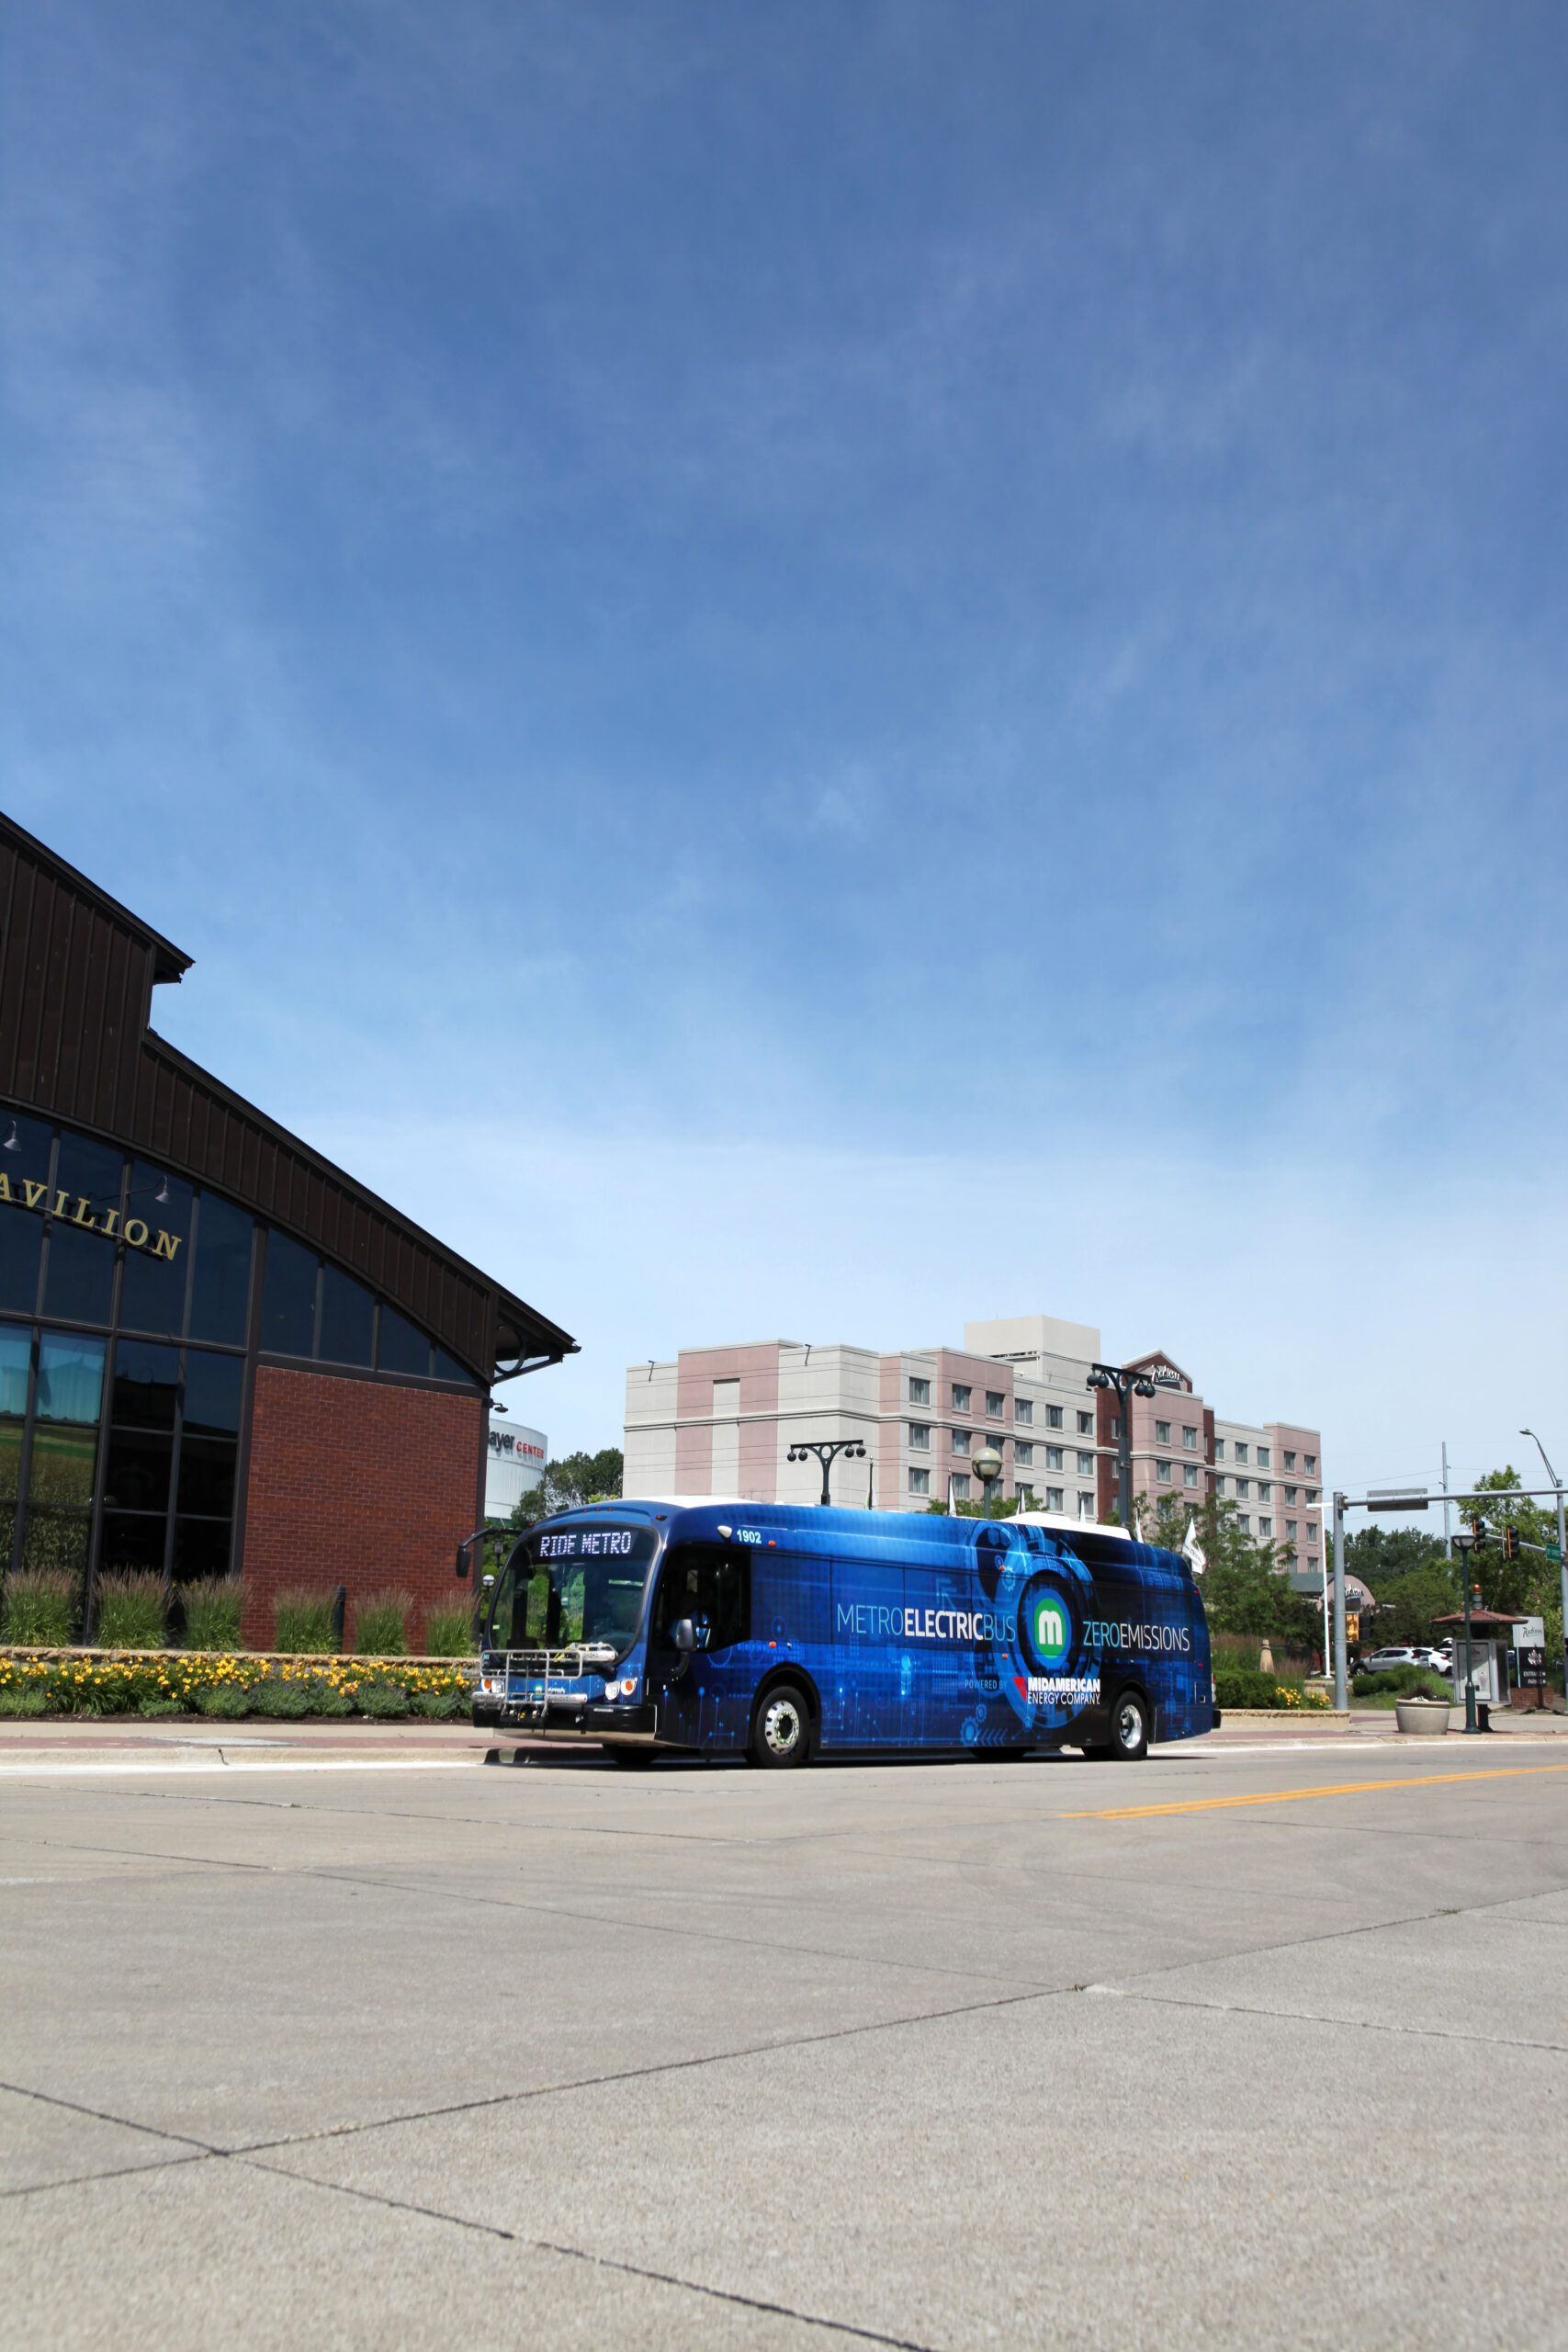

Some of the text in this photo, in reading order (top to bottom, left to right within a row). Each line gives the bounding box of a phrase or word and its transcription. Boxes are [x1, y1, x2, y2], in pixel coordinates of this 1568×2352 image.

[0, 1172, 182, 1261] AVILION
[488, 1430, 545, 1460] ayer CENTER
[540, 1532, 631, 1556] RIDE METRO
[737, 1529, 762, 1544] 1902
[964, 1679, 1008, 1690] POWERED BY
[1027, 1677, 1100, 1692] MIDAMERICAN
[1027, 1692, 1100, 1705] ENERGY COMPANY
